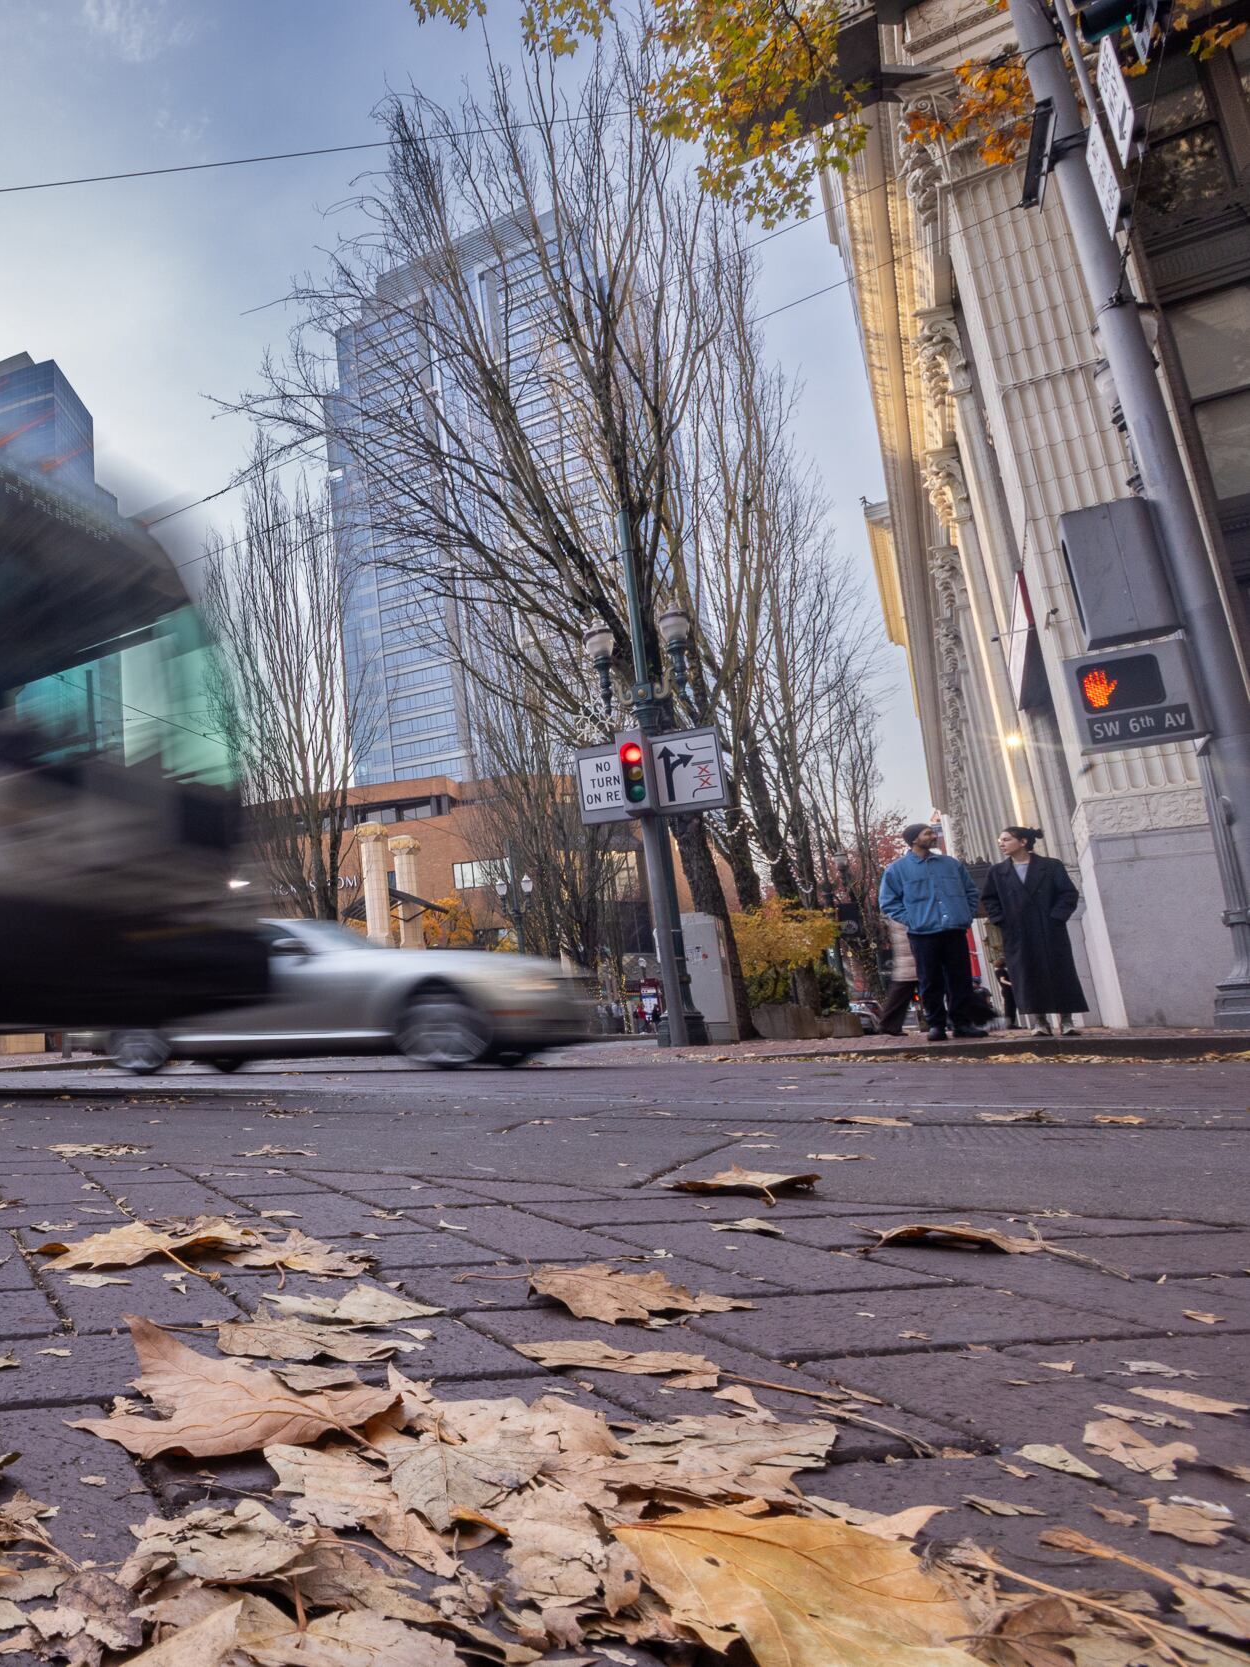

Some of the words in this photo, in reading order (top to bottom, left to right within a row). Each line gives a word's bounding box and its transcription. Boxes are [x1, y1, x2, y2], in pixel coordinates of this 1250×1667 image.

[1093, 721, 1120, 739] SW
[1129, 715, 1155, 733] 6th
[1164, 712, 1186, 728] Av
[595, 761, 611, 773] NO
[590, 775, 621, 789] TURN
[586, 793, 602, 805] ON
[606, 790, 621, 802] RE
